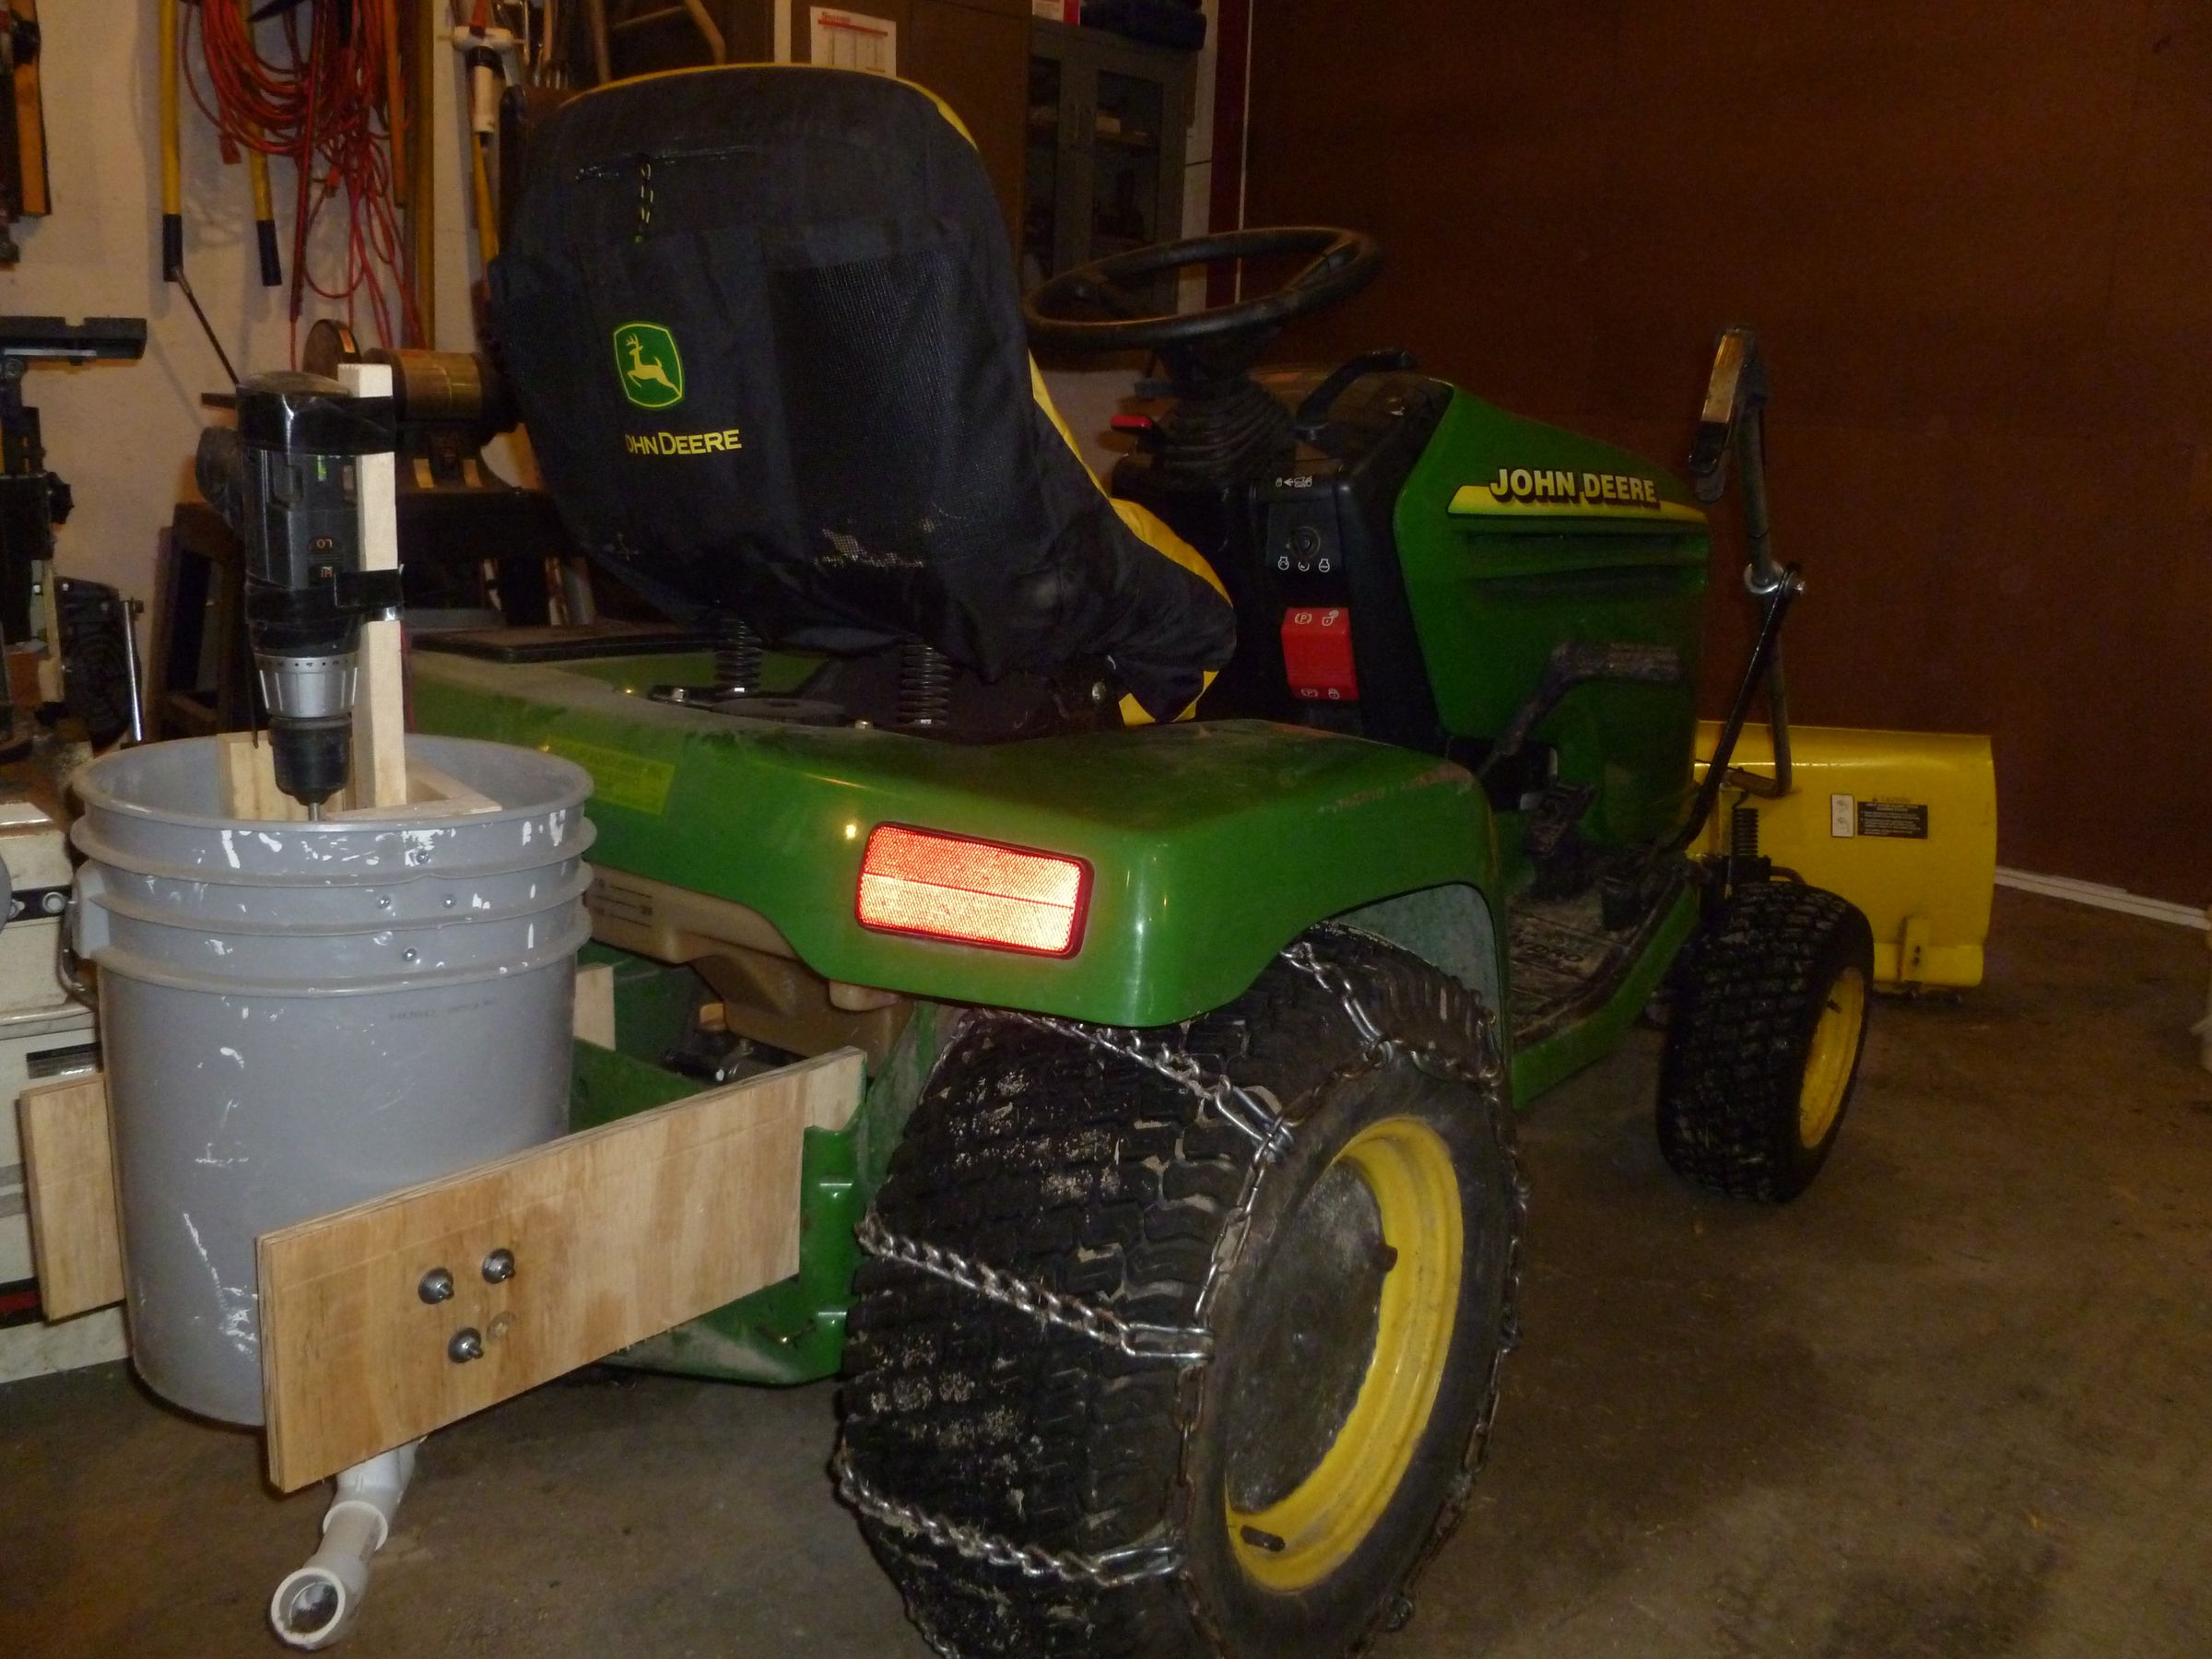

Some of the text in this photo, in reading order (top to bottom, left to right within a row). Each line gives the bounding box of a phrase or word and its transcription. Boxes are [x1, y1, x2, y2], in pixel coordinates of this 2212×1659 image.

[625, 429, 743, 455] OHN DEERE
[1489, 468, 1661, 508] JOHN DEERE
